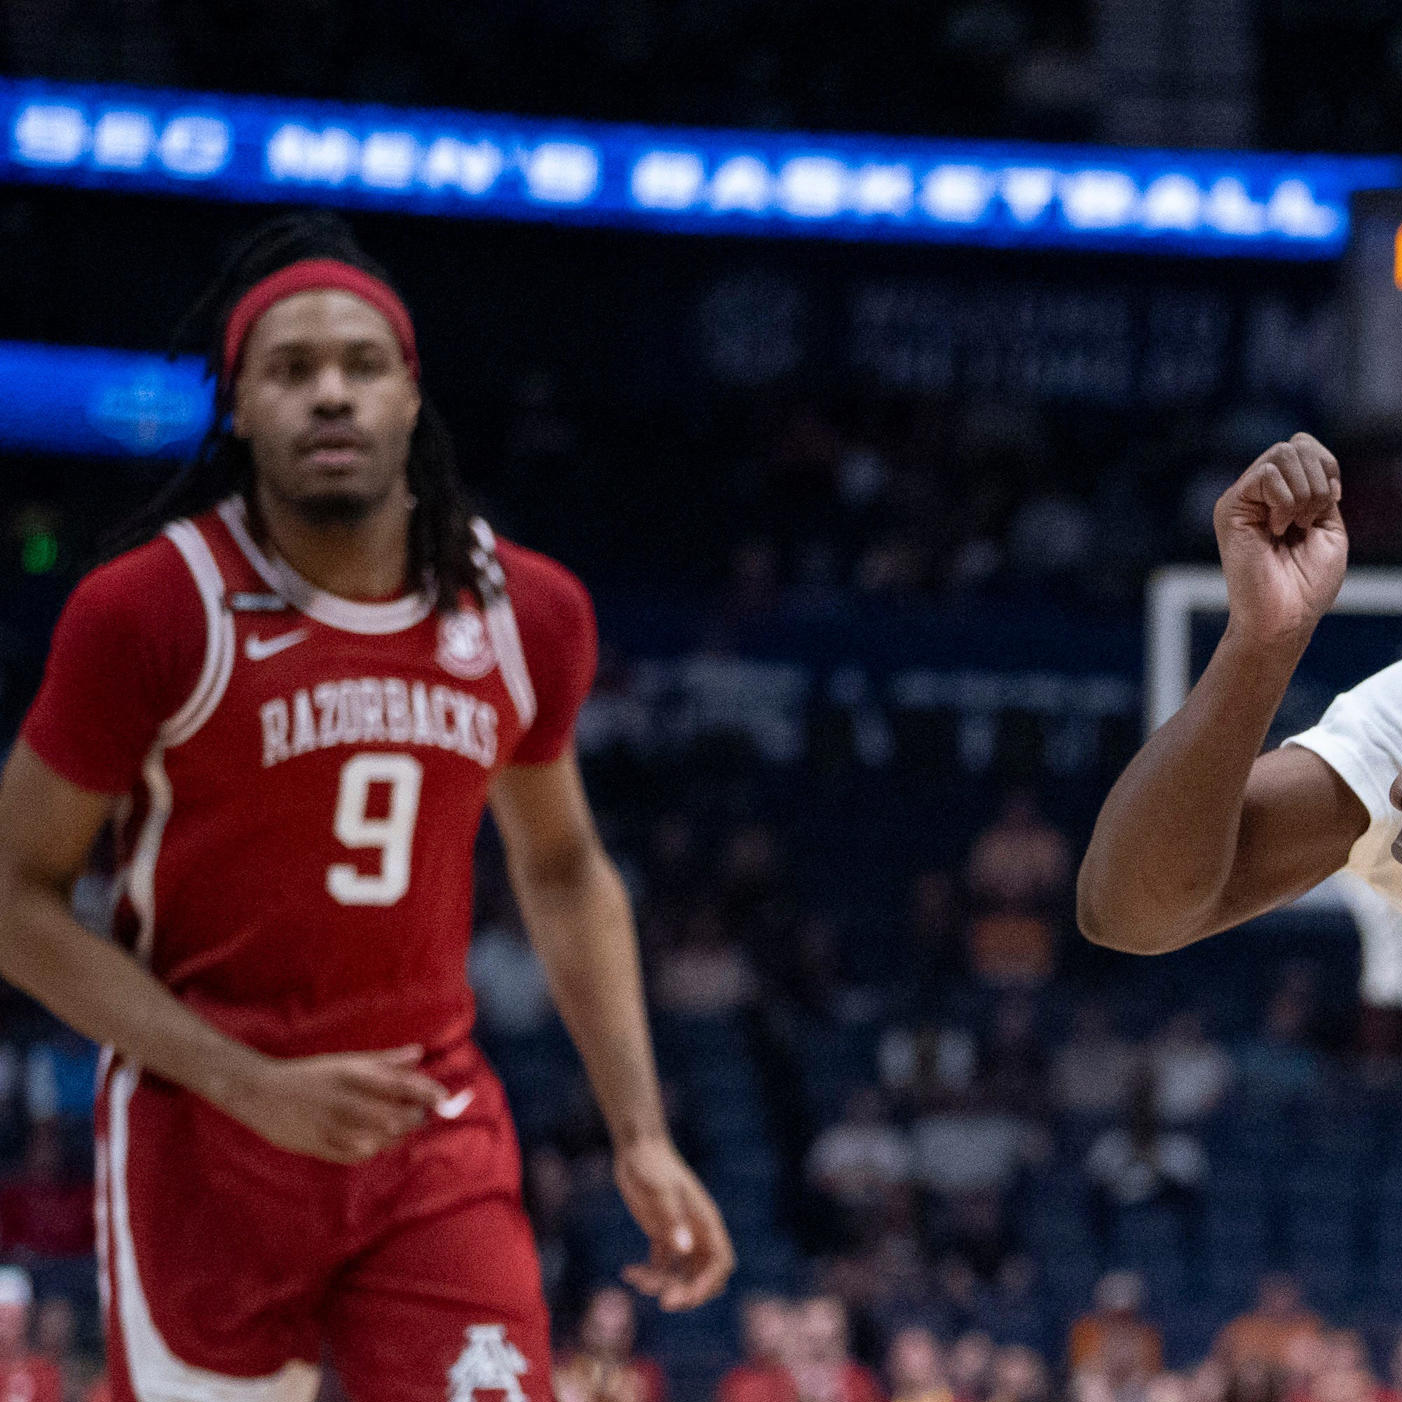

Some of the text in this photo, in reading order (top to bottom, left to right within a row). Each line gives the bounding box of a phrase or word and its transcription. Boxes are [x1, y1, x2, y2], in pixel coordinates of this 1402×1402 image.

[630, 148, 1348, 240] BASKETBALL
[260, 676, 498, 768] RAZORBACKS
[326, 751, 423, 905] 9
